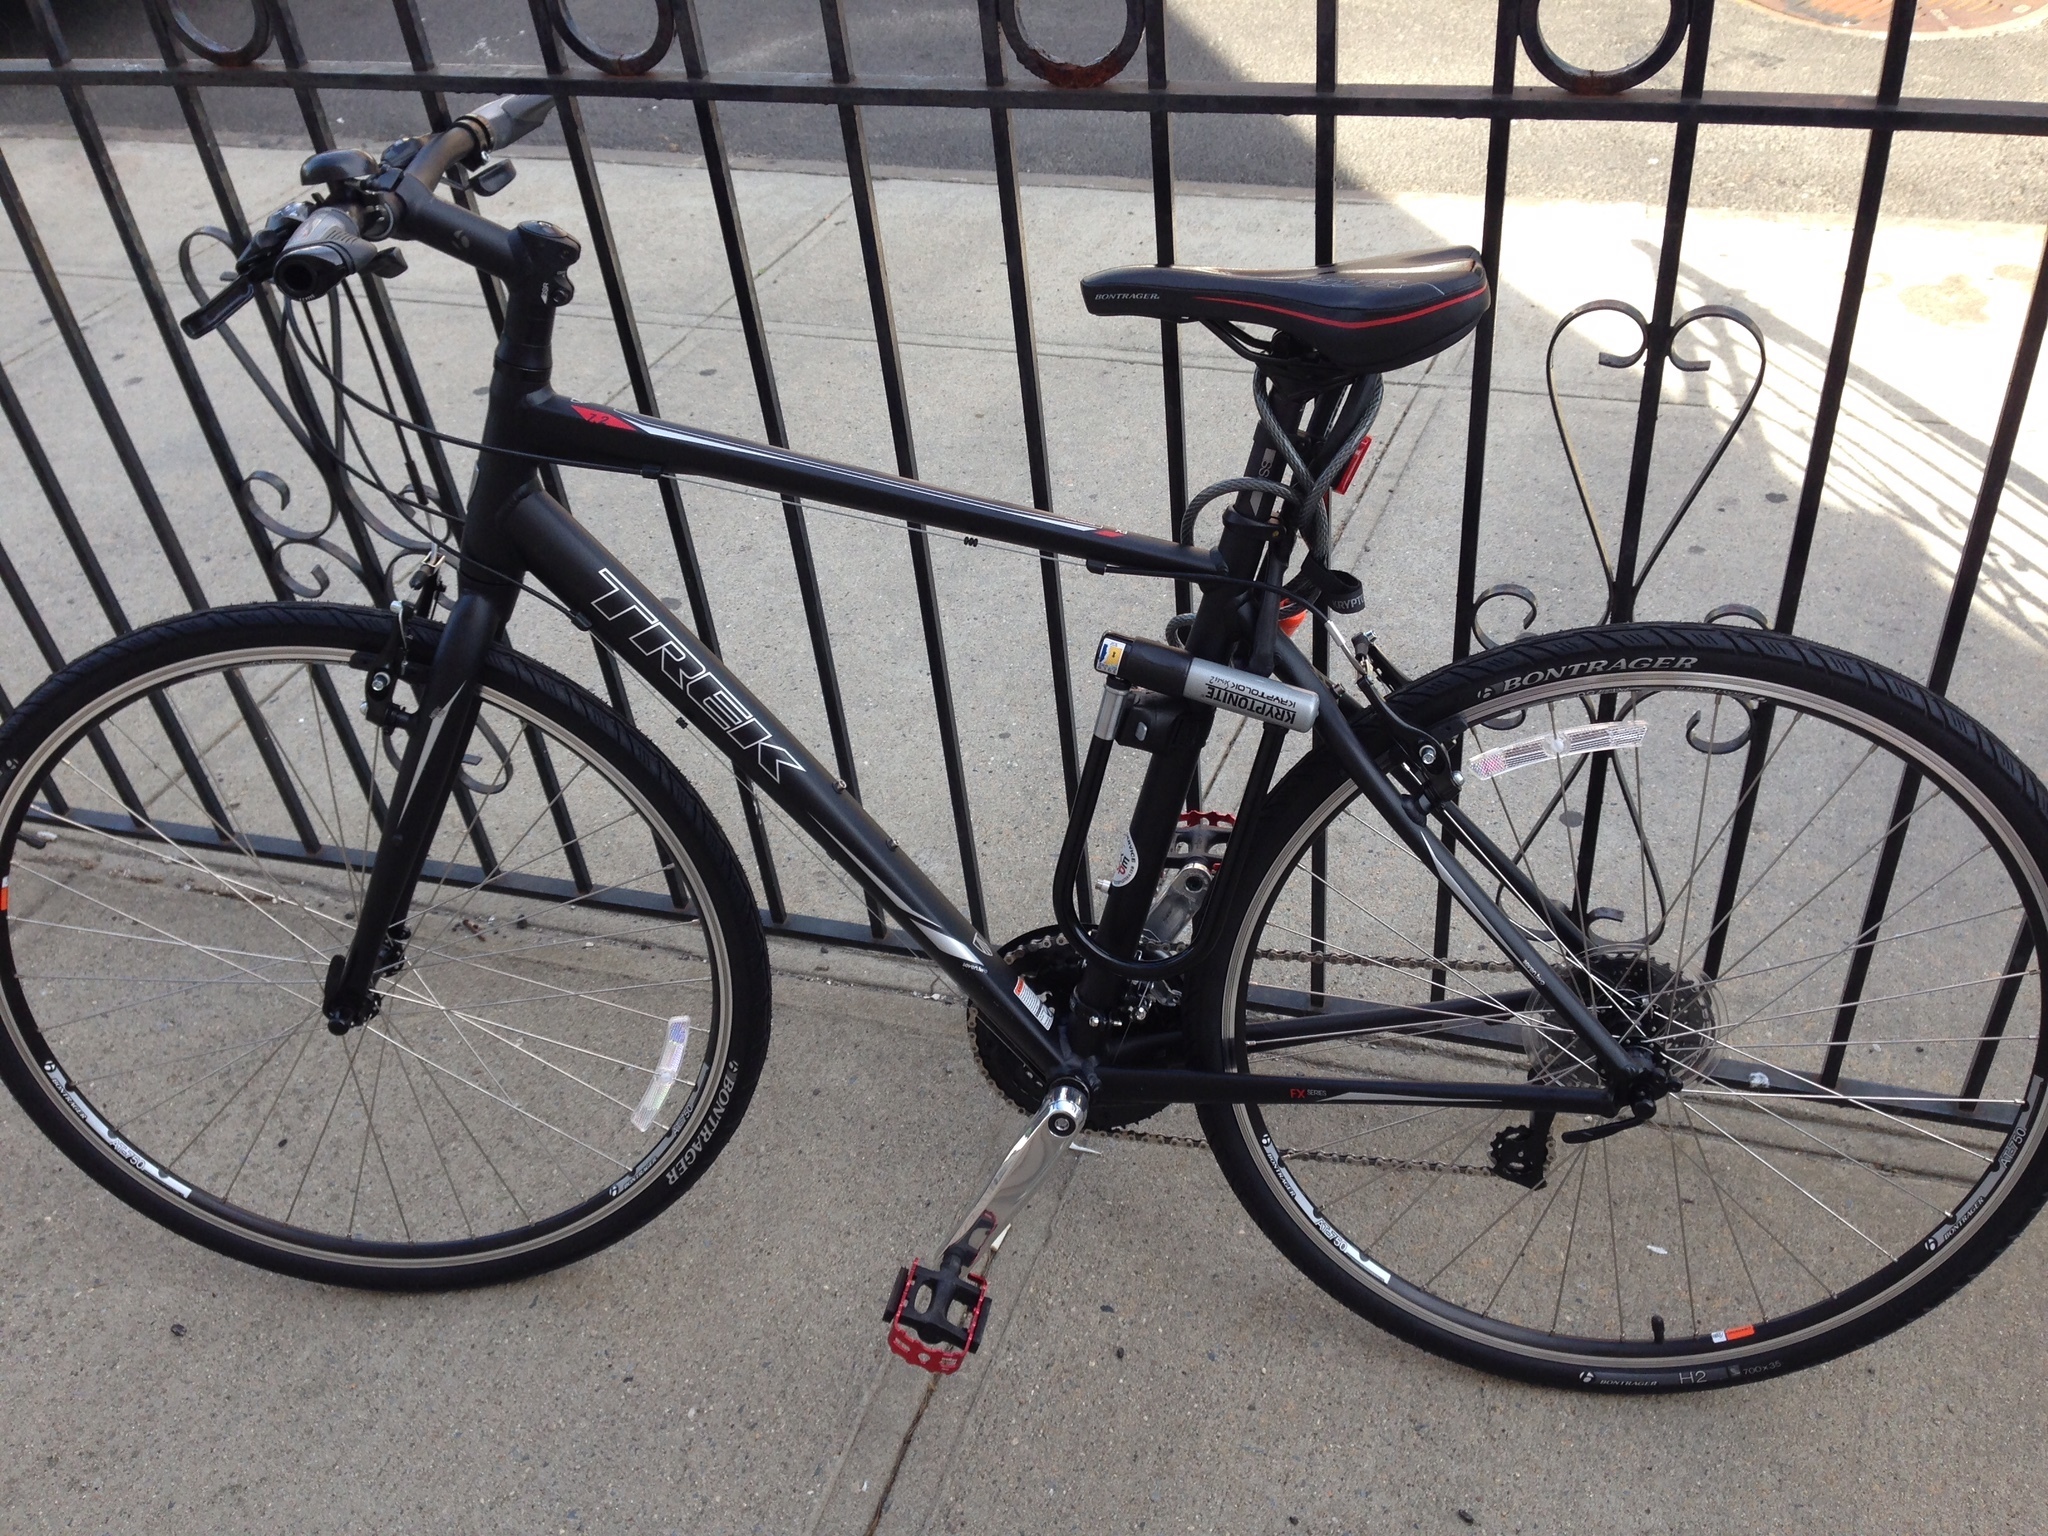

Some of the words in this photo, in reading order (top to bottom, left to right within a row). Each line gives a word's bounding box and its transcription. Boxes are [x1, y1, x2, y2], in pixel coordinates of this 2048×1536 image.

[1095, 293, 1160, 301] BONTRAGER
[591, 568, 806, 784] TREK
[1502, 656, 1699, 692] BONTRAGER
[1205, 686, 1296, 725] KRYPTONITE
[1231, 682, 1296, 708] KRYPTOLOK
[1290, 1088, 1306, 1098] FX
[665, 1078, 735, 1186] BONTRAGER
[1679, 1371, 1707, 1384] H2
